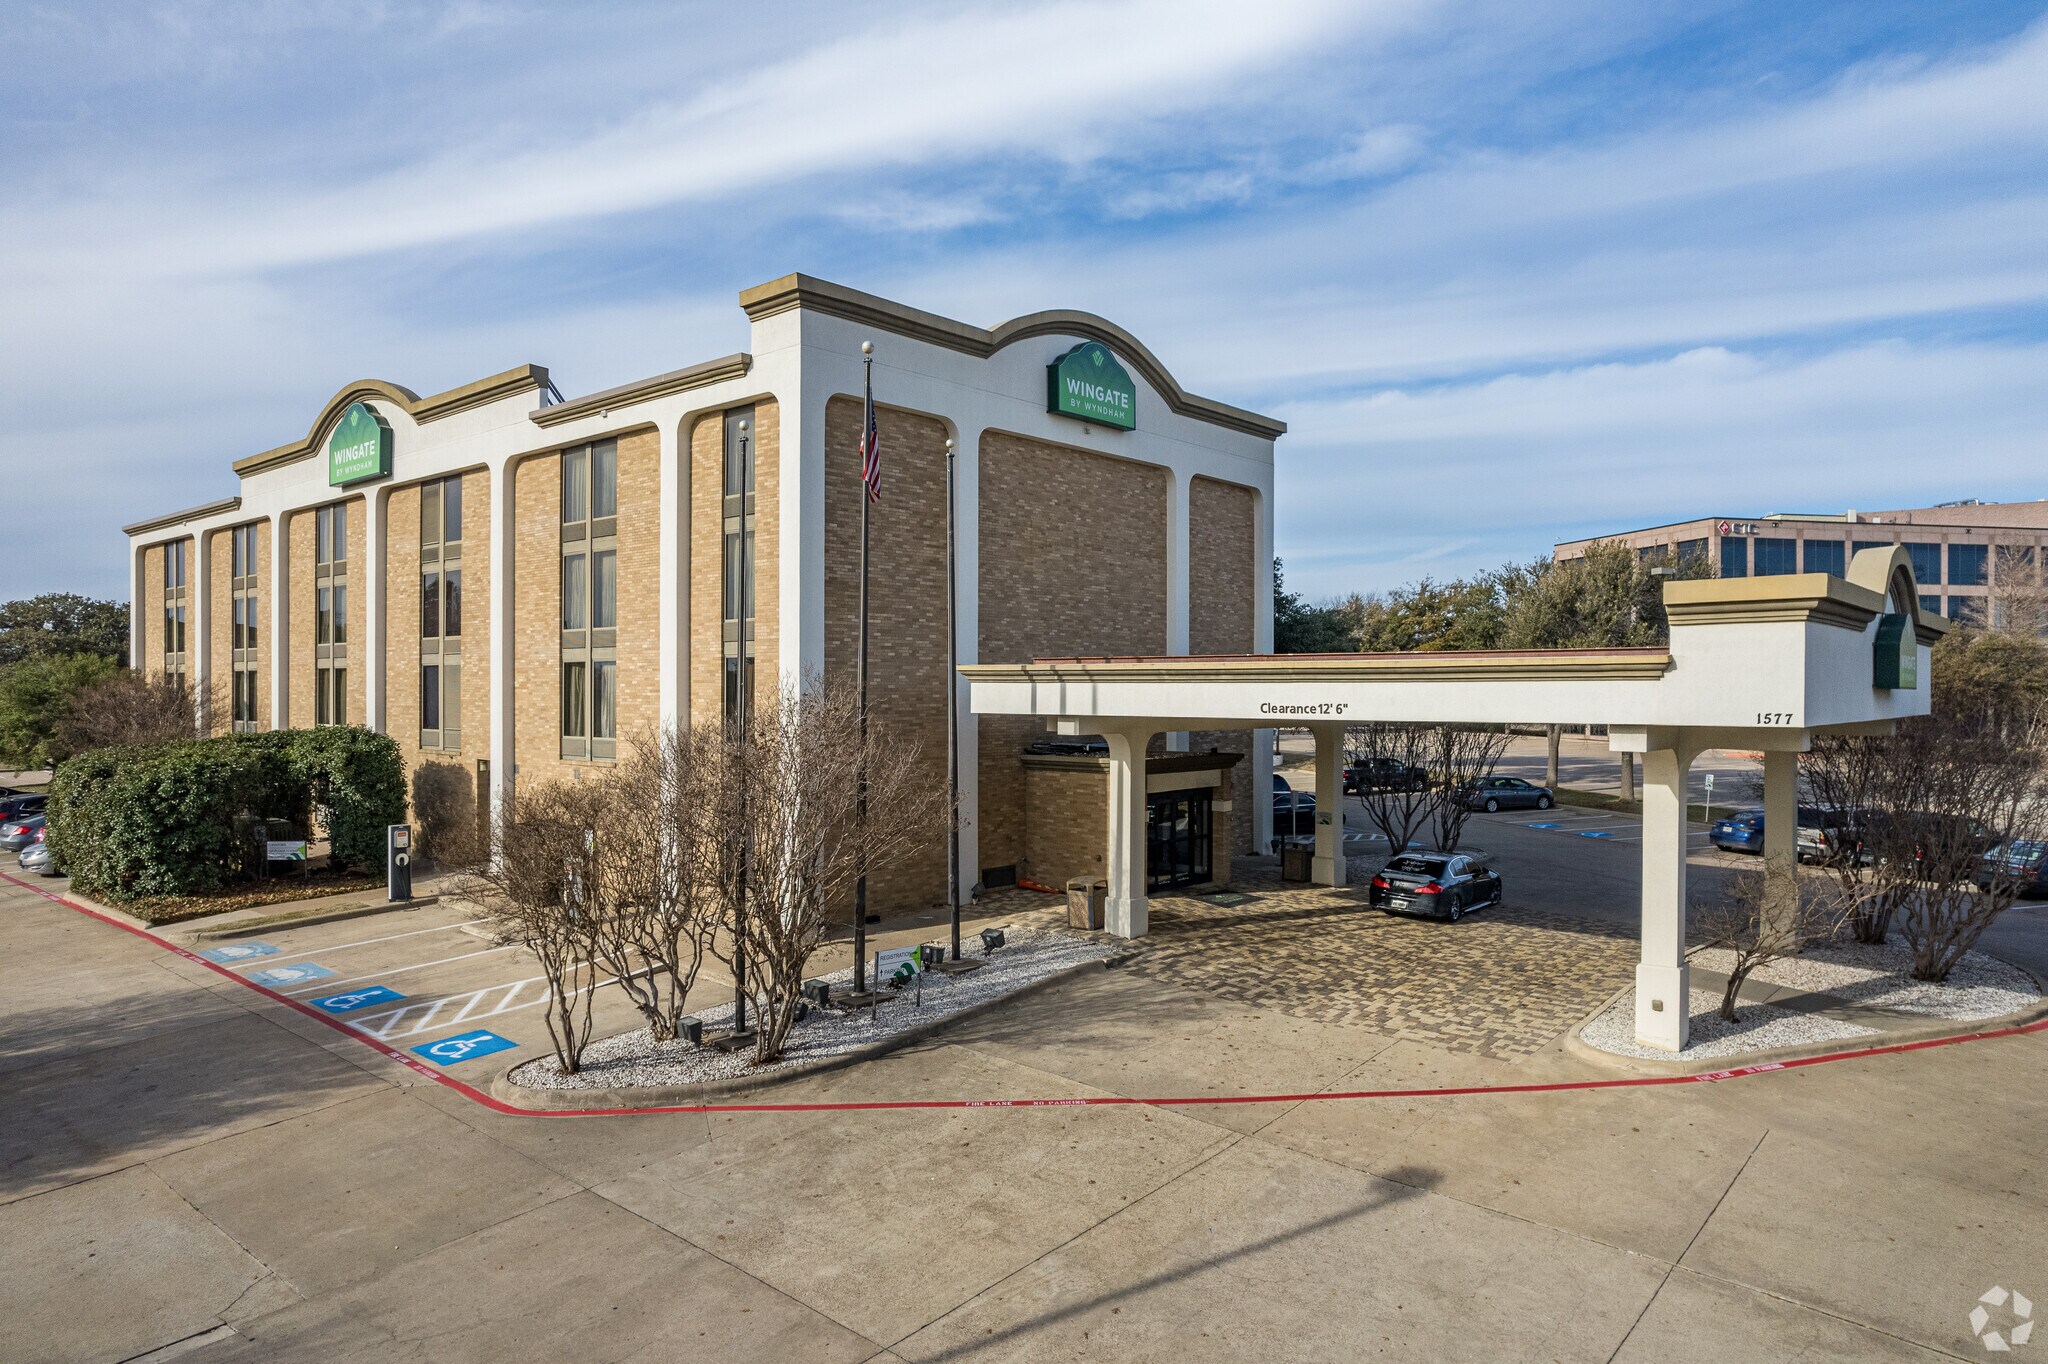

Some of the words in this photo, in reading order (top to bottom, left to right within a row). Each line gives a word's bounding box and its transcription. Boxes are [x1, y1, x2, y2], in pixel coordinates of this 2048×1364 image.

[1066, 377, 1129, 409] WINGATE
[1070, 398, 1081, 408] BY
[1084, 401, 1125, 420] WYNDHAM
[334, 440, 376, 466] WINGATE
[336, 468, 344, 477] BY
[344, 460, 373, 474] WYNDHAM
[1260, 702, 1317, 714] Clearance
[1317, 703, 1333, 715] 12'
[1335, 703, 1349, 715] 6"
[1756, 712, 1794, 725] 1577
[880, 951, 912, 961] REGISTRATION
